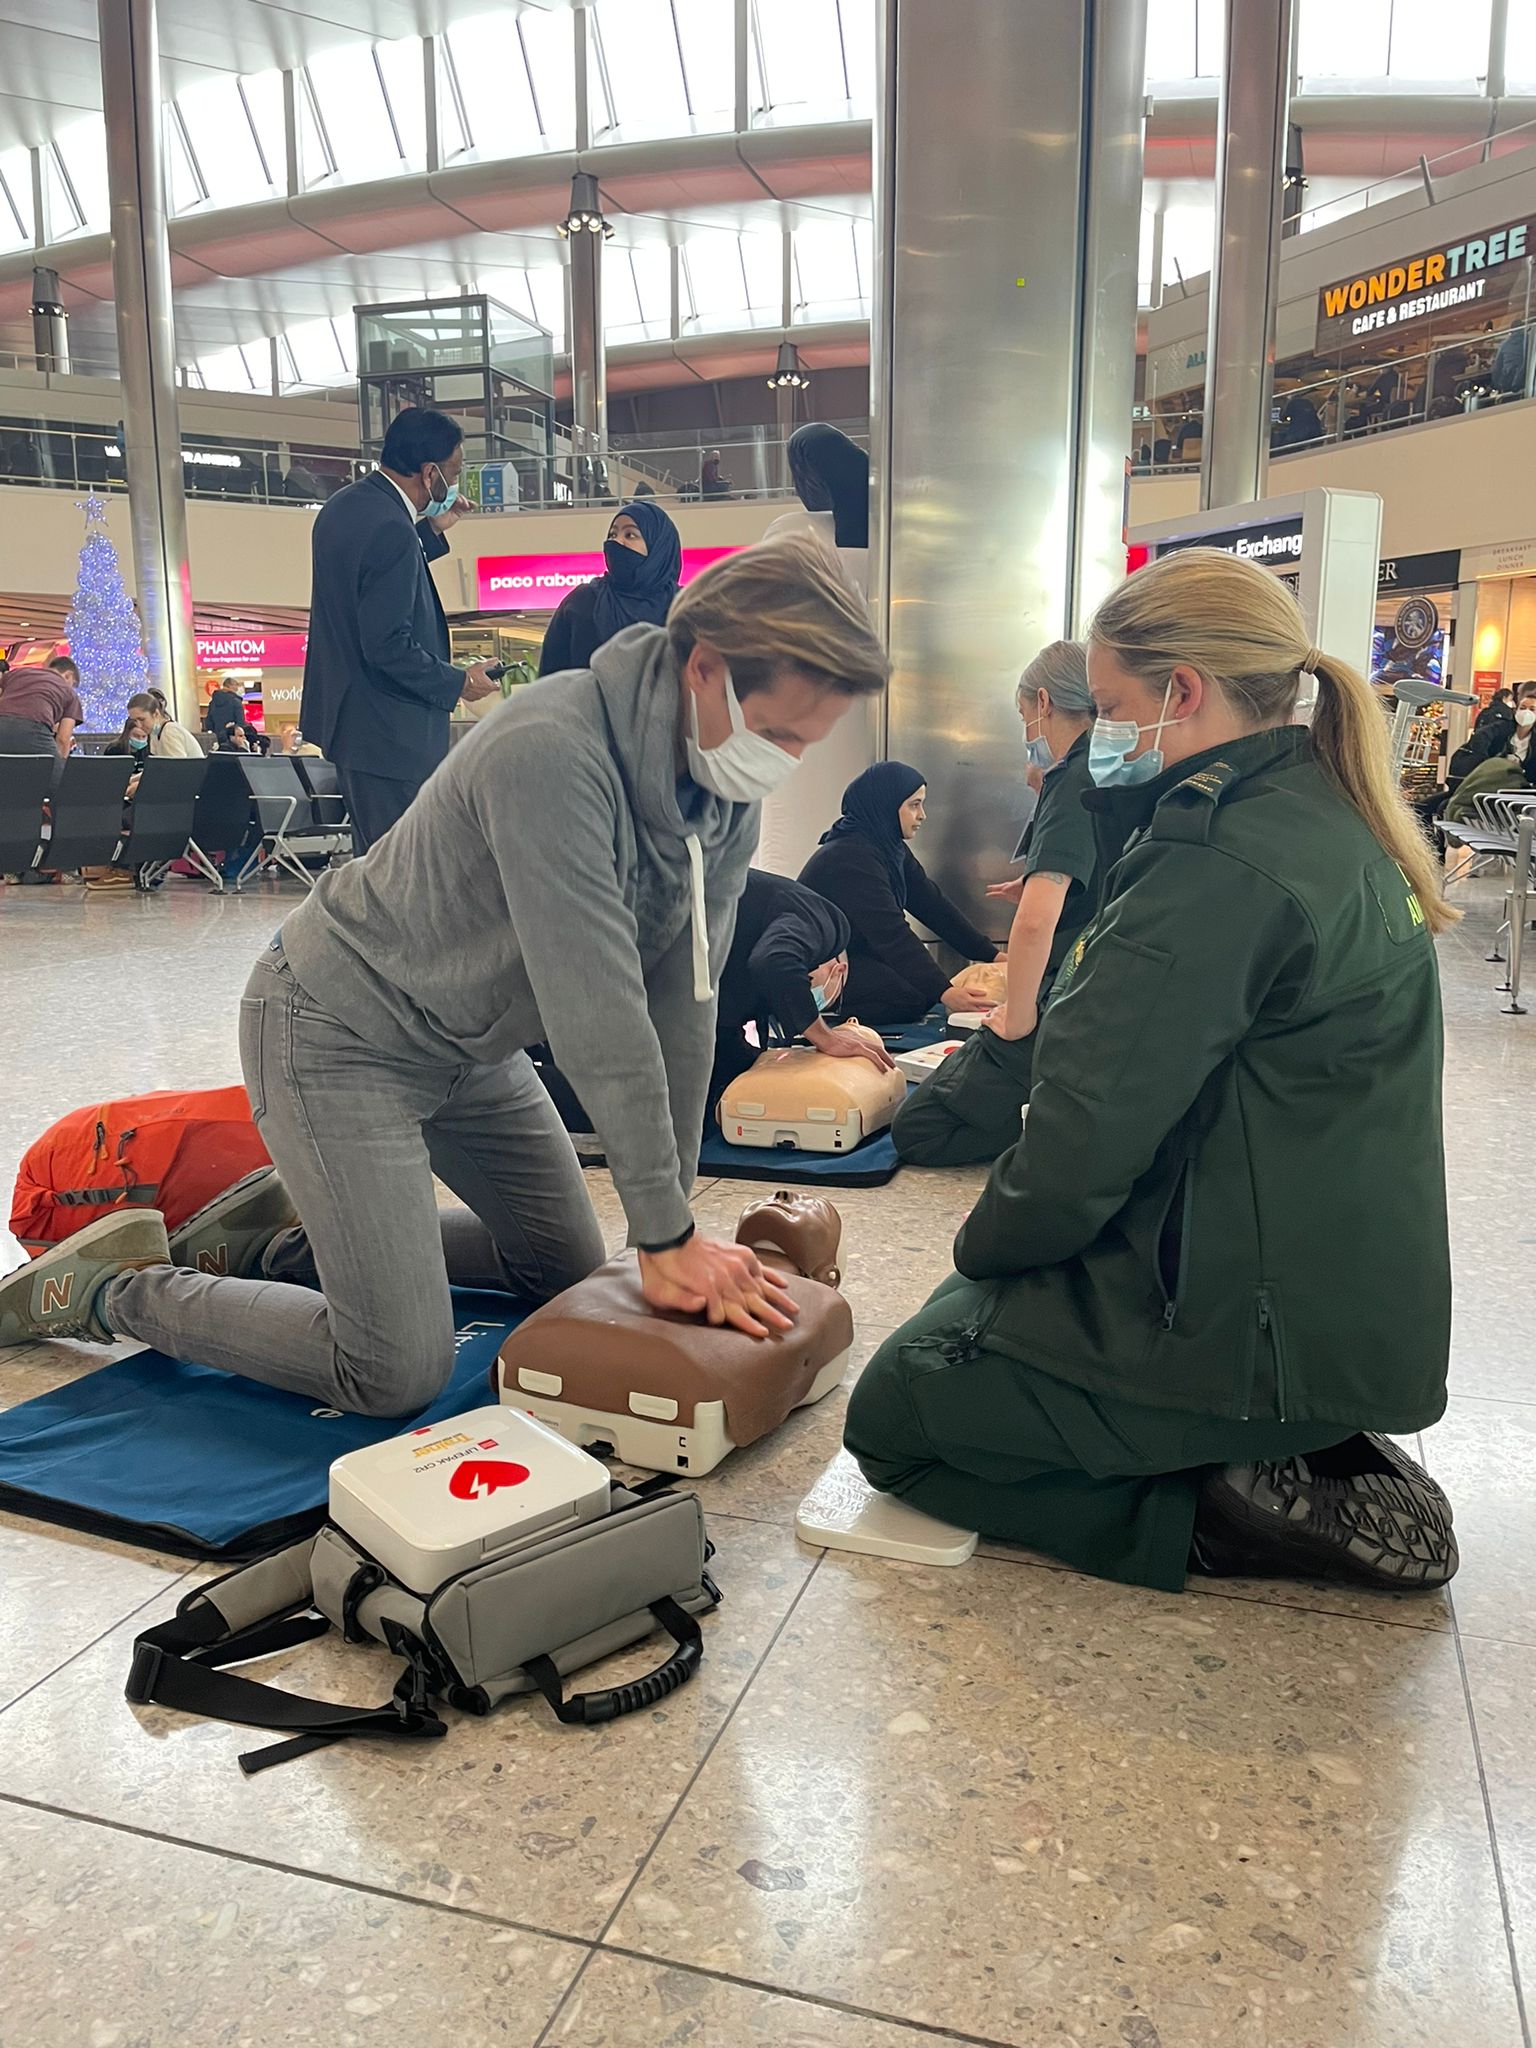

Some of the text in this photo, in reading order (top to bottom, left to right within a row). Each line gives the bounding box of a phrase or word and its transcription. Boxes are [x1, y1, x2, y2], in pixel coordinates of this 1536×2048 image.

[1324, 225, 1528, 318] WONDERTREE
[1352, 279, 1486, 336] CAFE & RESTAURANT
[1236, 534, 1303, 558] Exchang
[1496, 561, 1524, 571] DINNER
[1499, 554, 1524, 563] LUNCH
[490, 576, 533, 591] paco
[196, 640, 265, 655] PHANTOM
[197, 1243, 228, 1275] N
[41, 1272, 75, 1314] N
[413, 1434, 474, 1458] Trainer
[413, 1446, 479, 1474] LIFEPAK CR2
